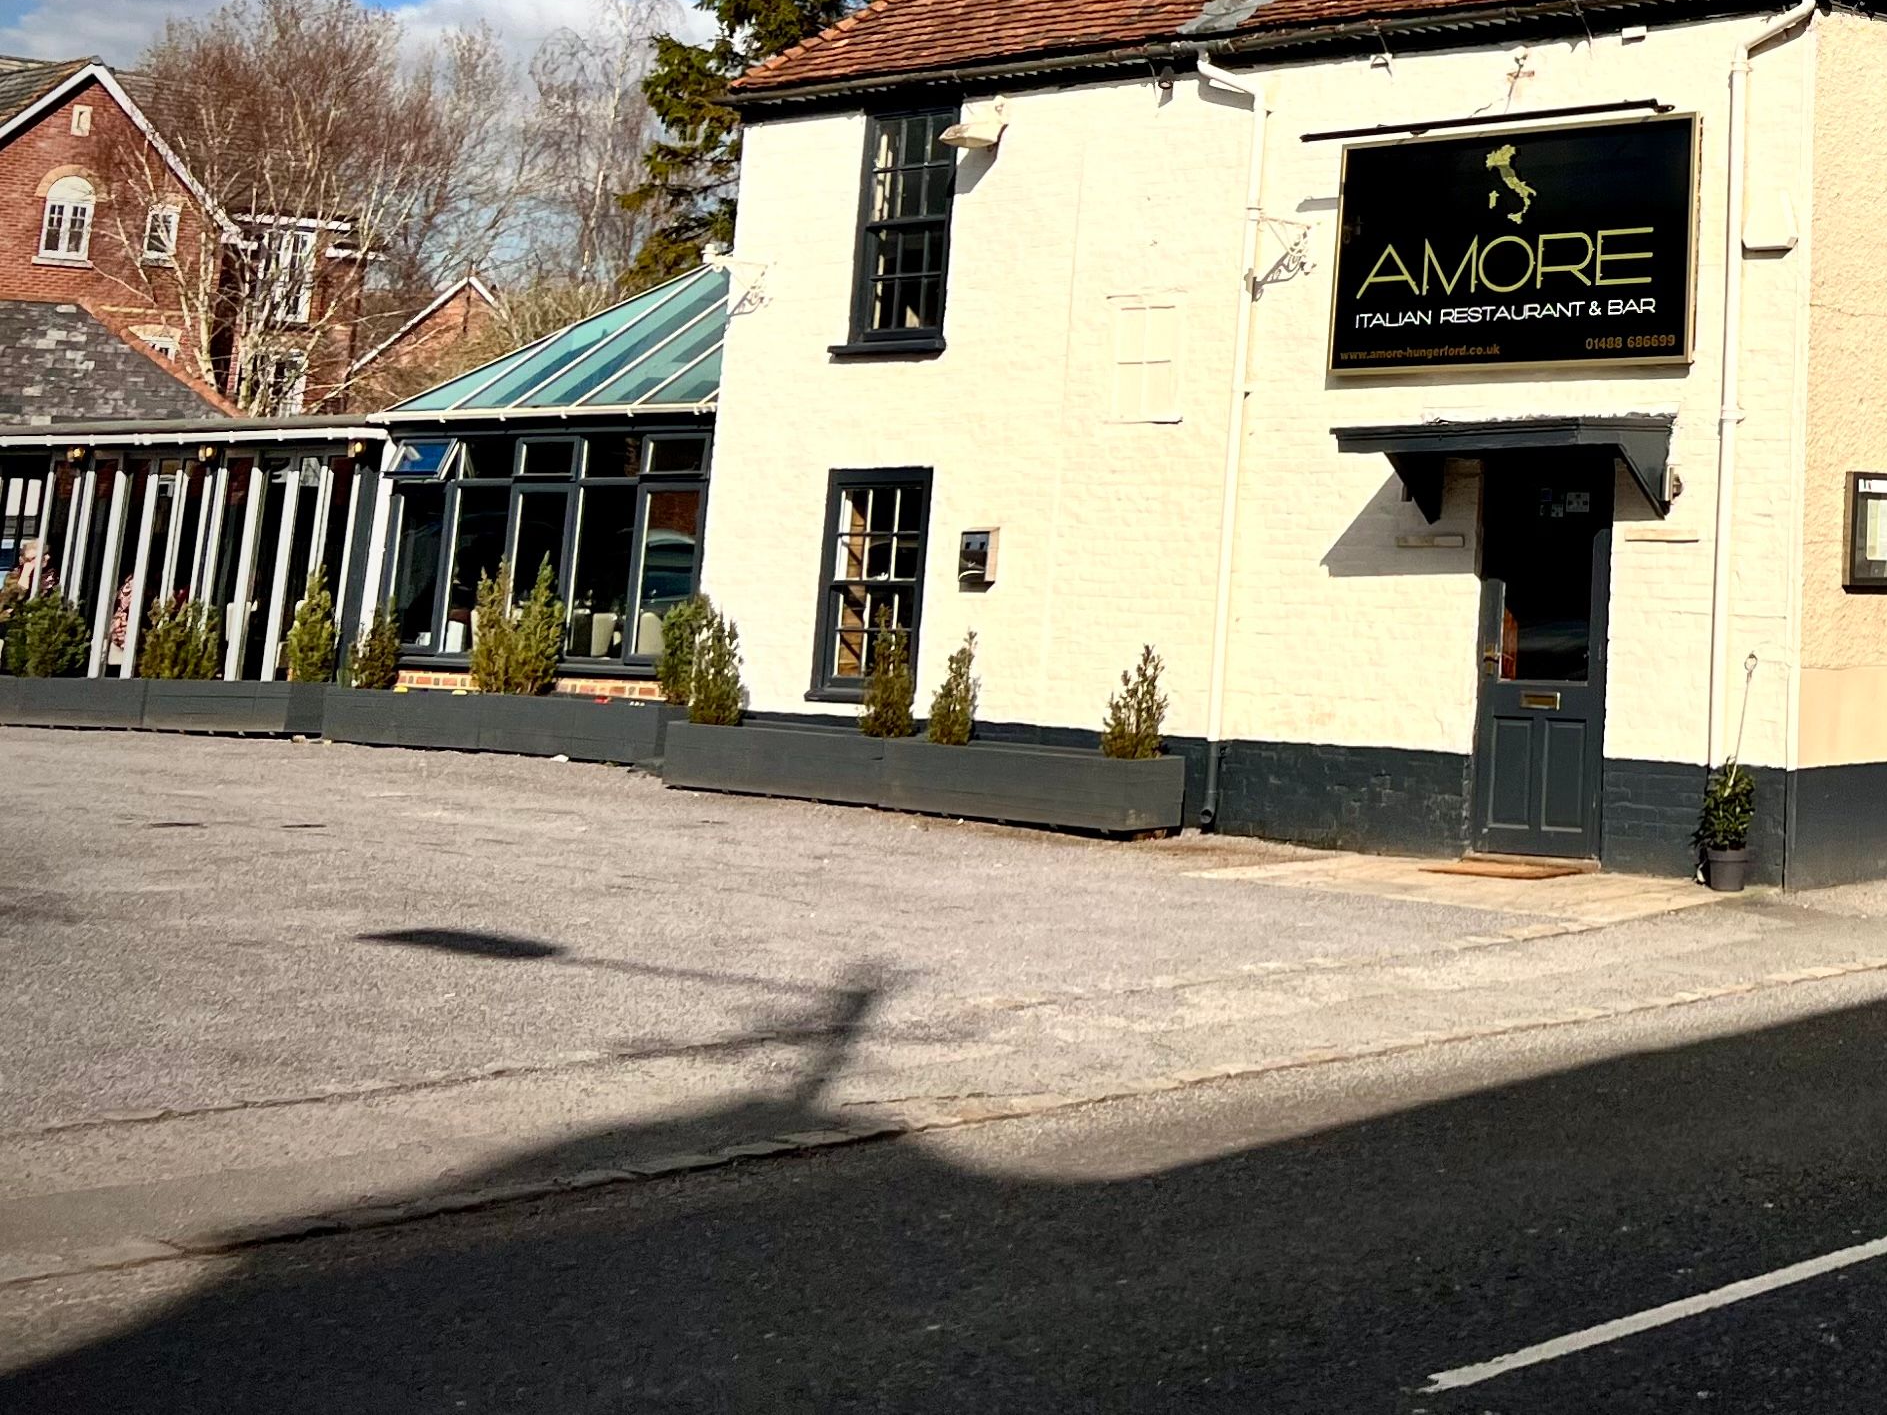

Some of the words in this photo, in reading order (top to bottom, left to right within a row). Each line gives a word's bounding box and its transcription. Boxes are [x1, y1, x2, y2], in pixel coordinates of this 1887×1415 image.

[1356, 226, 1654, 299] AMORE
[1355, 310, 1432, 328] ITALIAN
[1440, 301, 1585, 324] RESTAURANT
[1588, 301, 1602, 316] &
[1607, 297, 1656, 315] BAR
[1339, 343, 1501, 360] www.amore-hungerford.co.uk
[1585, 337, 1623, 350] 01488
[1627, 334, 1676, 348] 686699
